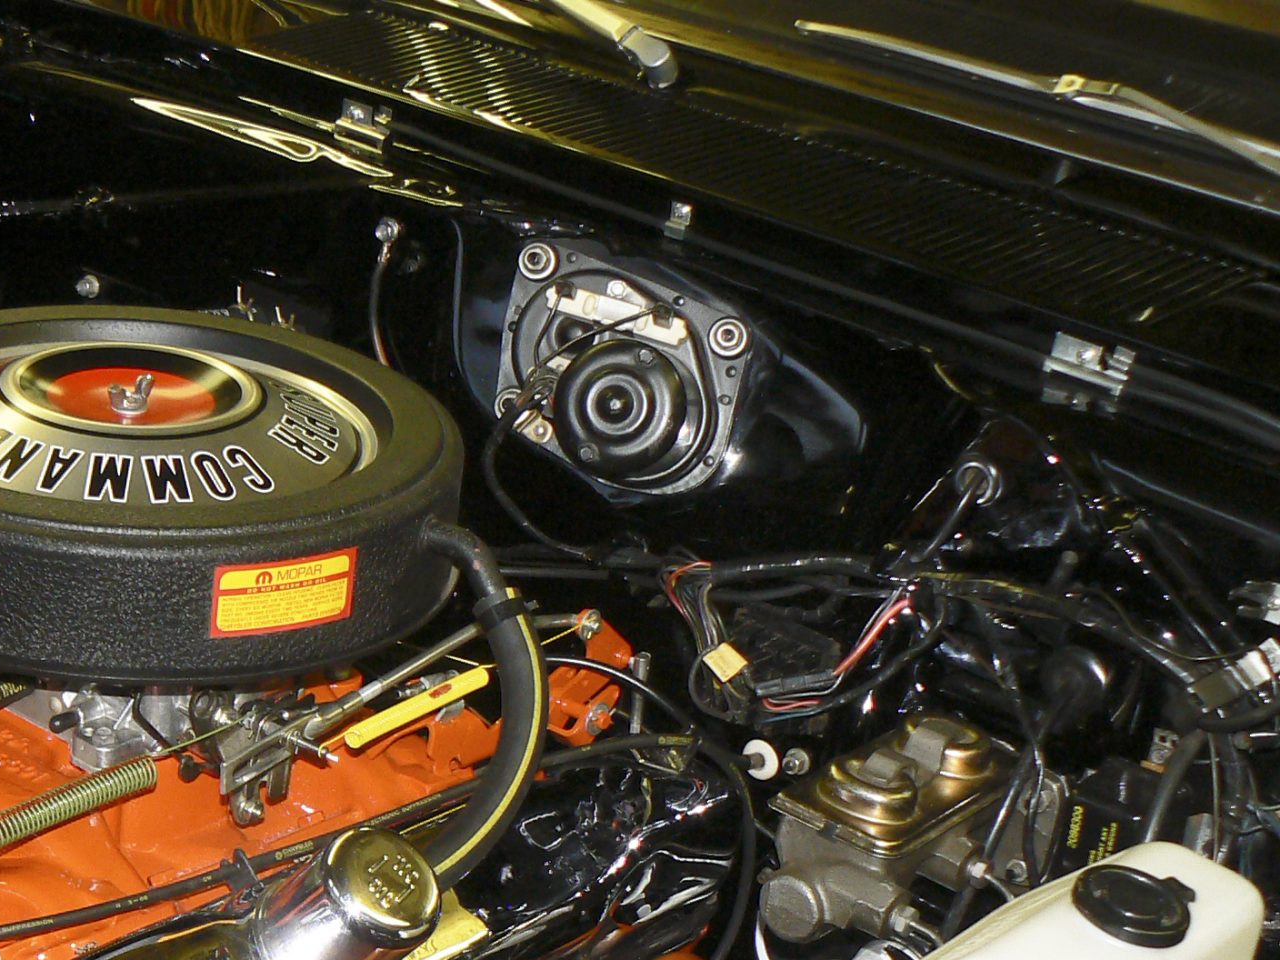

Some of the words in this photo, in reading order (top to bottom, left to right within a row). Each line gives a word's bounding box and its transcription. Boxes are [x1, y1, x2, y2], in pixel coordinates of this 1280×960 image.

[277, 564, 322, 581] MOPAR
[260, 585, 276, 593] NOT
[279, 582, 300, 590] WASH
